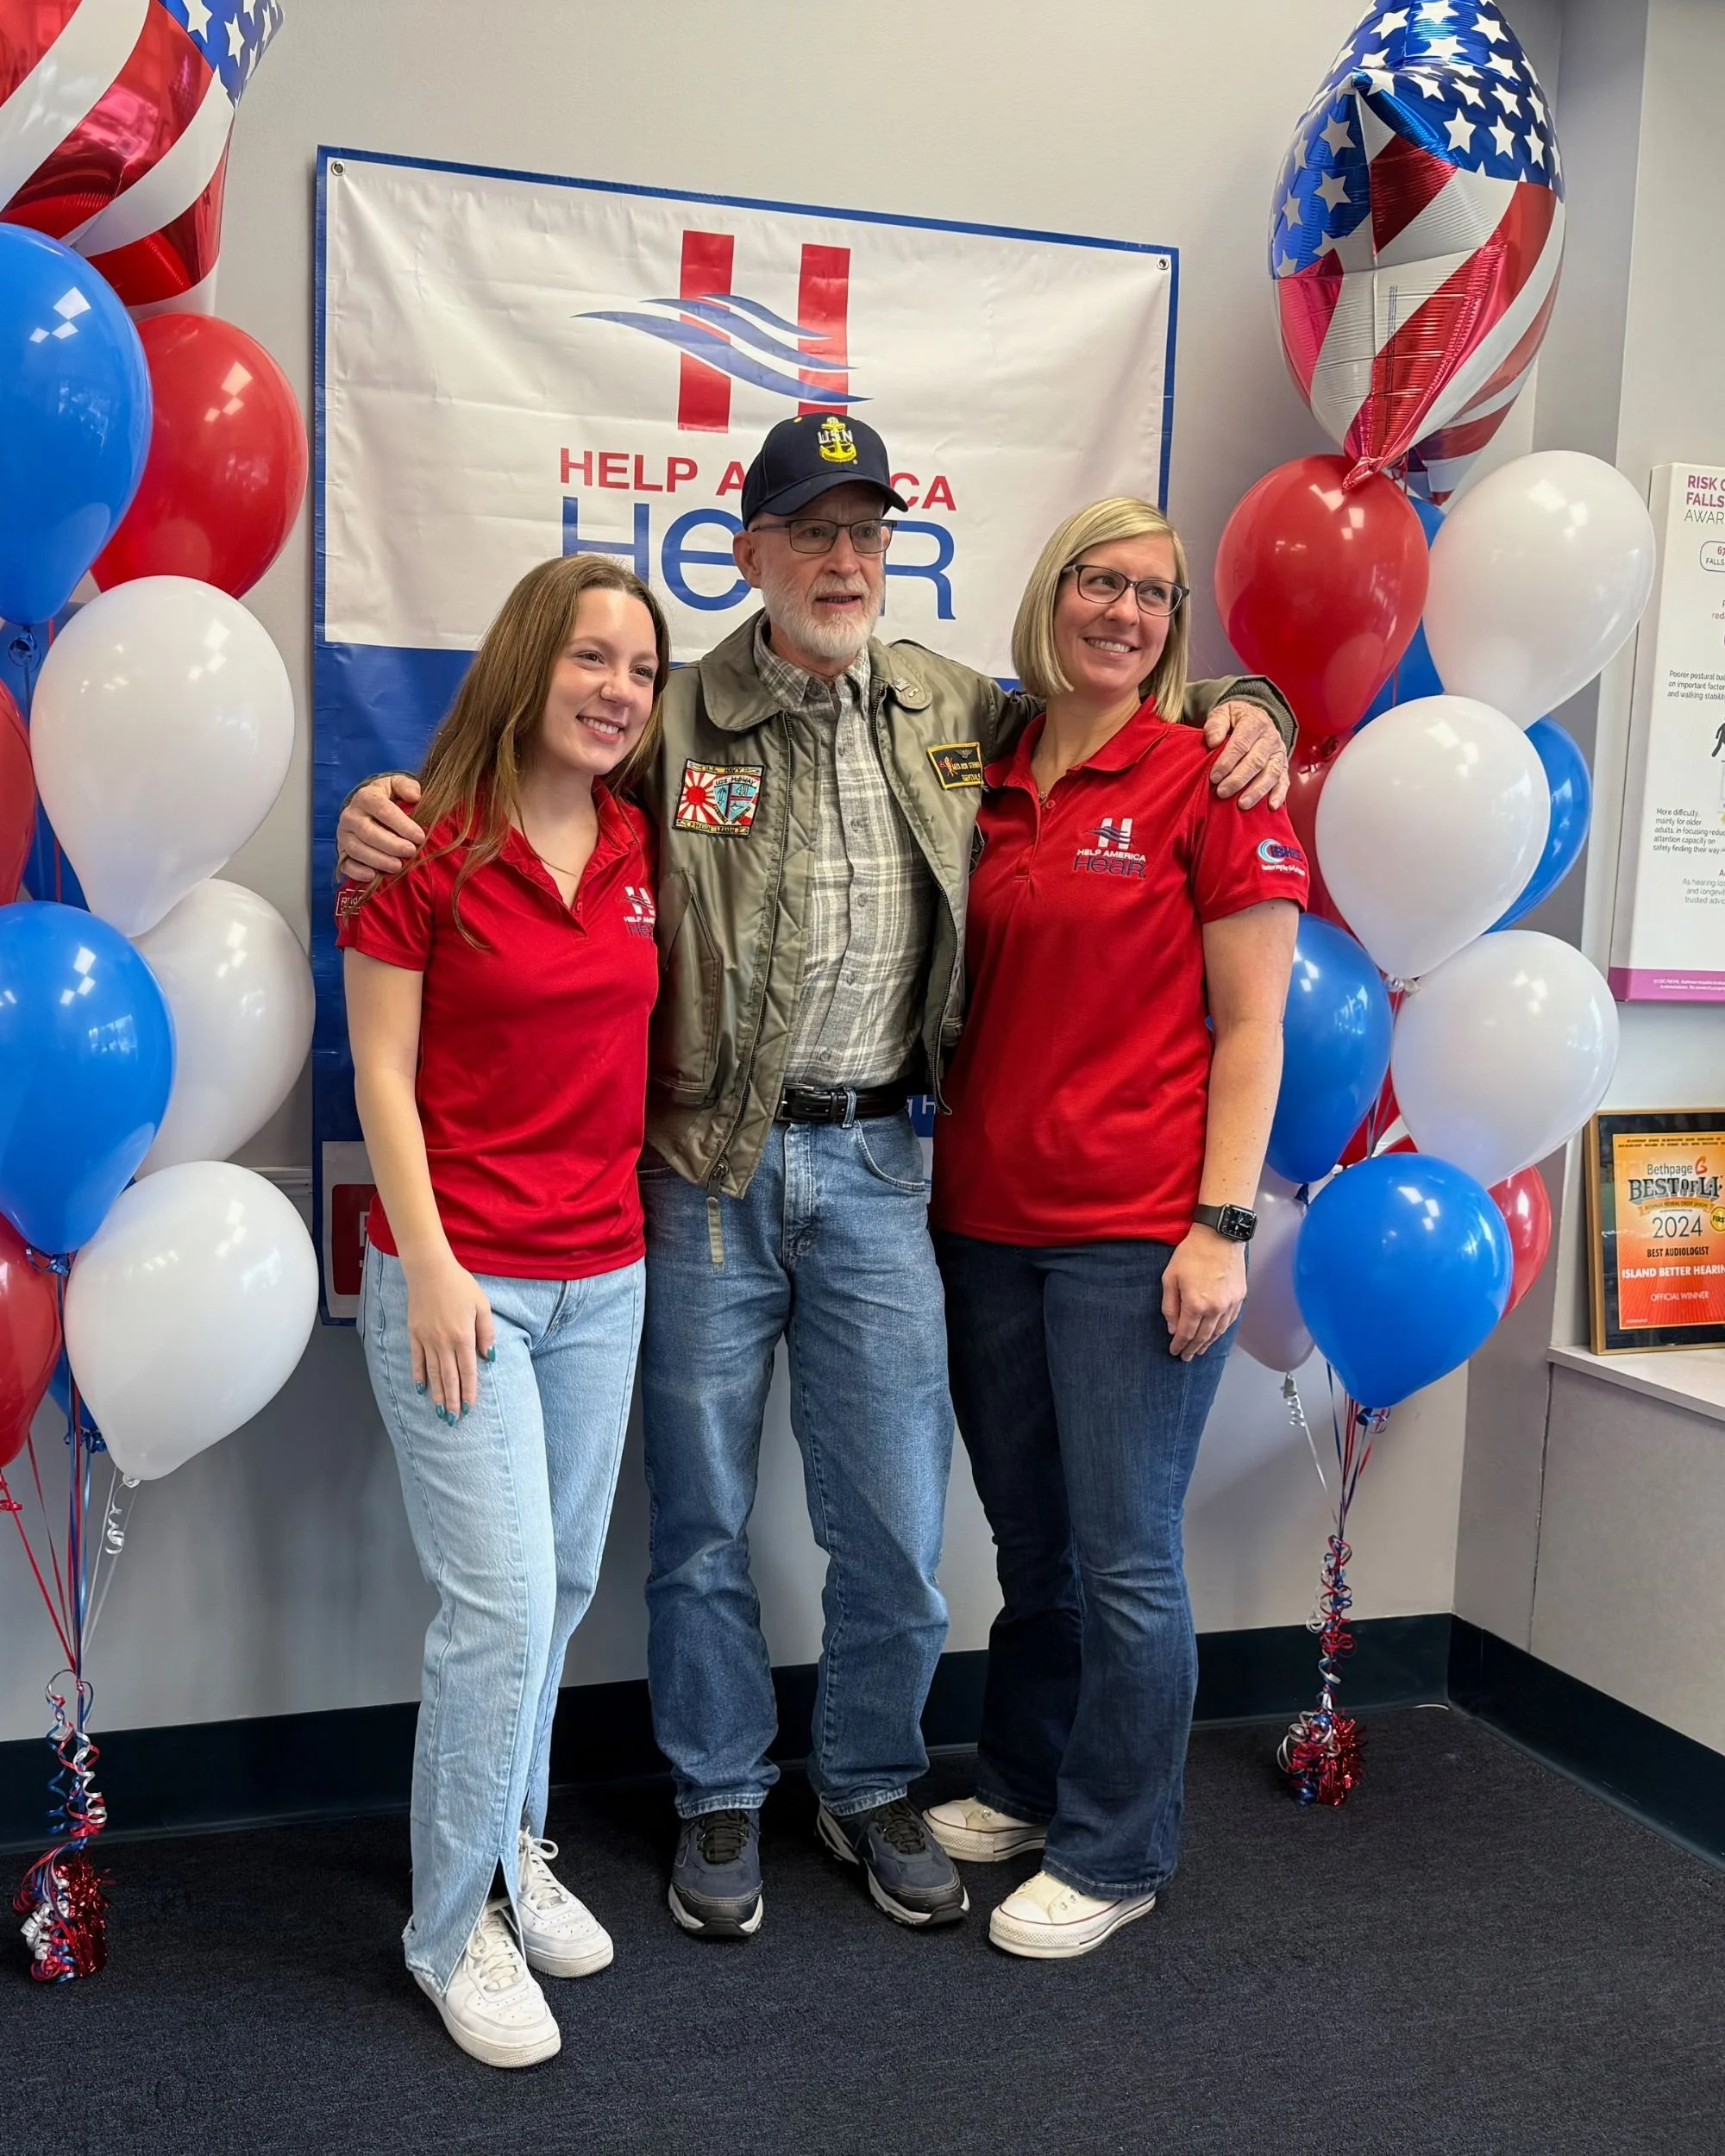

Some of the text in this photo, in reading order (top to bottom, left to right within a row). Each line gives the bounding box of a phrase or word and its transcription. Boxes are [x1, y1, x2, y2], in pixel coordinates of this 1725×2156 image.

[817, 429, 854, 445] USN
[560, 448, 699, 493] HELP
[1687, 474, 1718, 491] RISK
[1685, 492, 1725, 508] FALLS
[561, 495, 957, 621] HeR
[1705, 557, 1725, 566] FALLS
[731, 776, 756, 785] MIDWAY
[1103, 849, 1146, 862] AMERICA
[1647, 1163, 1692, 1177] Bethpage
[1628, 1178, 1680, 1201] BEST
[1652, 1215, 1703, 1238] 2024
[1647, 1246, 1709, 1258] BEST AUDIOLOGIST
[1622, 1268, 1657, 1279] ISLAND
[1658, 1265, 1691, 1277] BETTER
[1650, 1290, 1709, 1302] OFFICIAL WINNER
